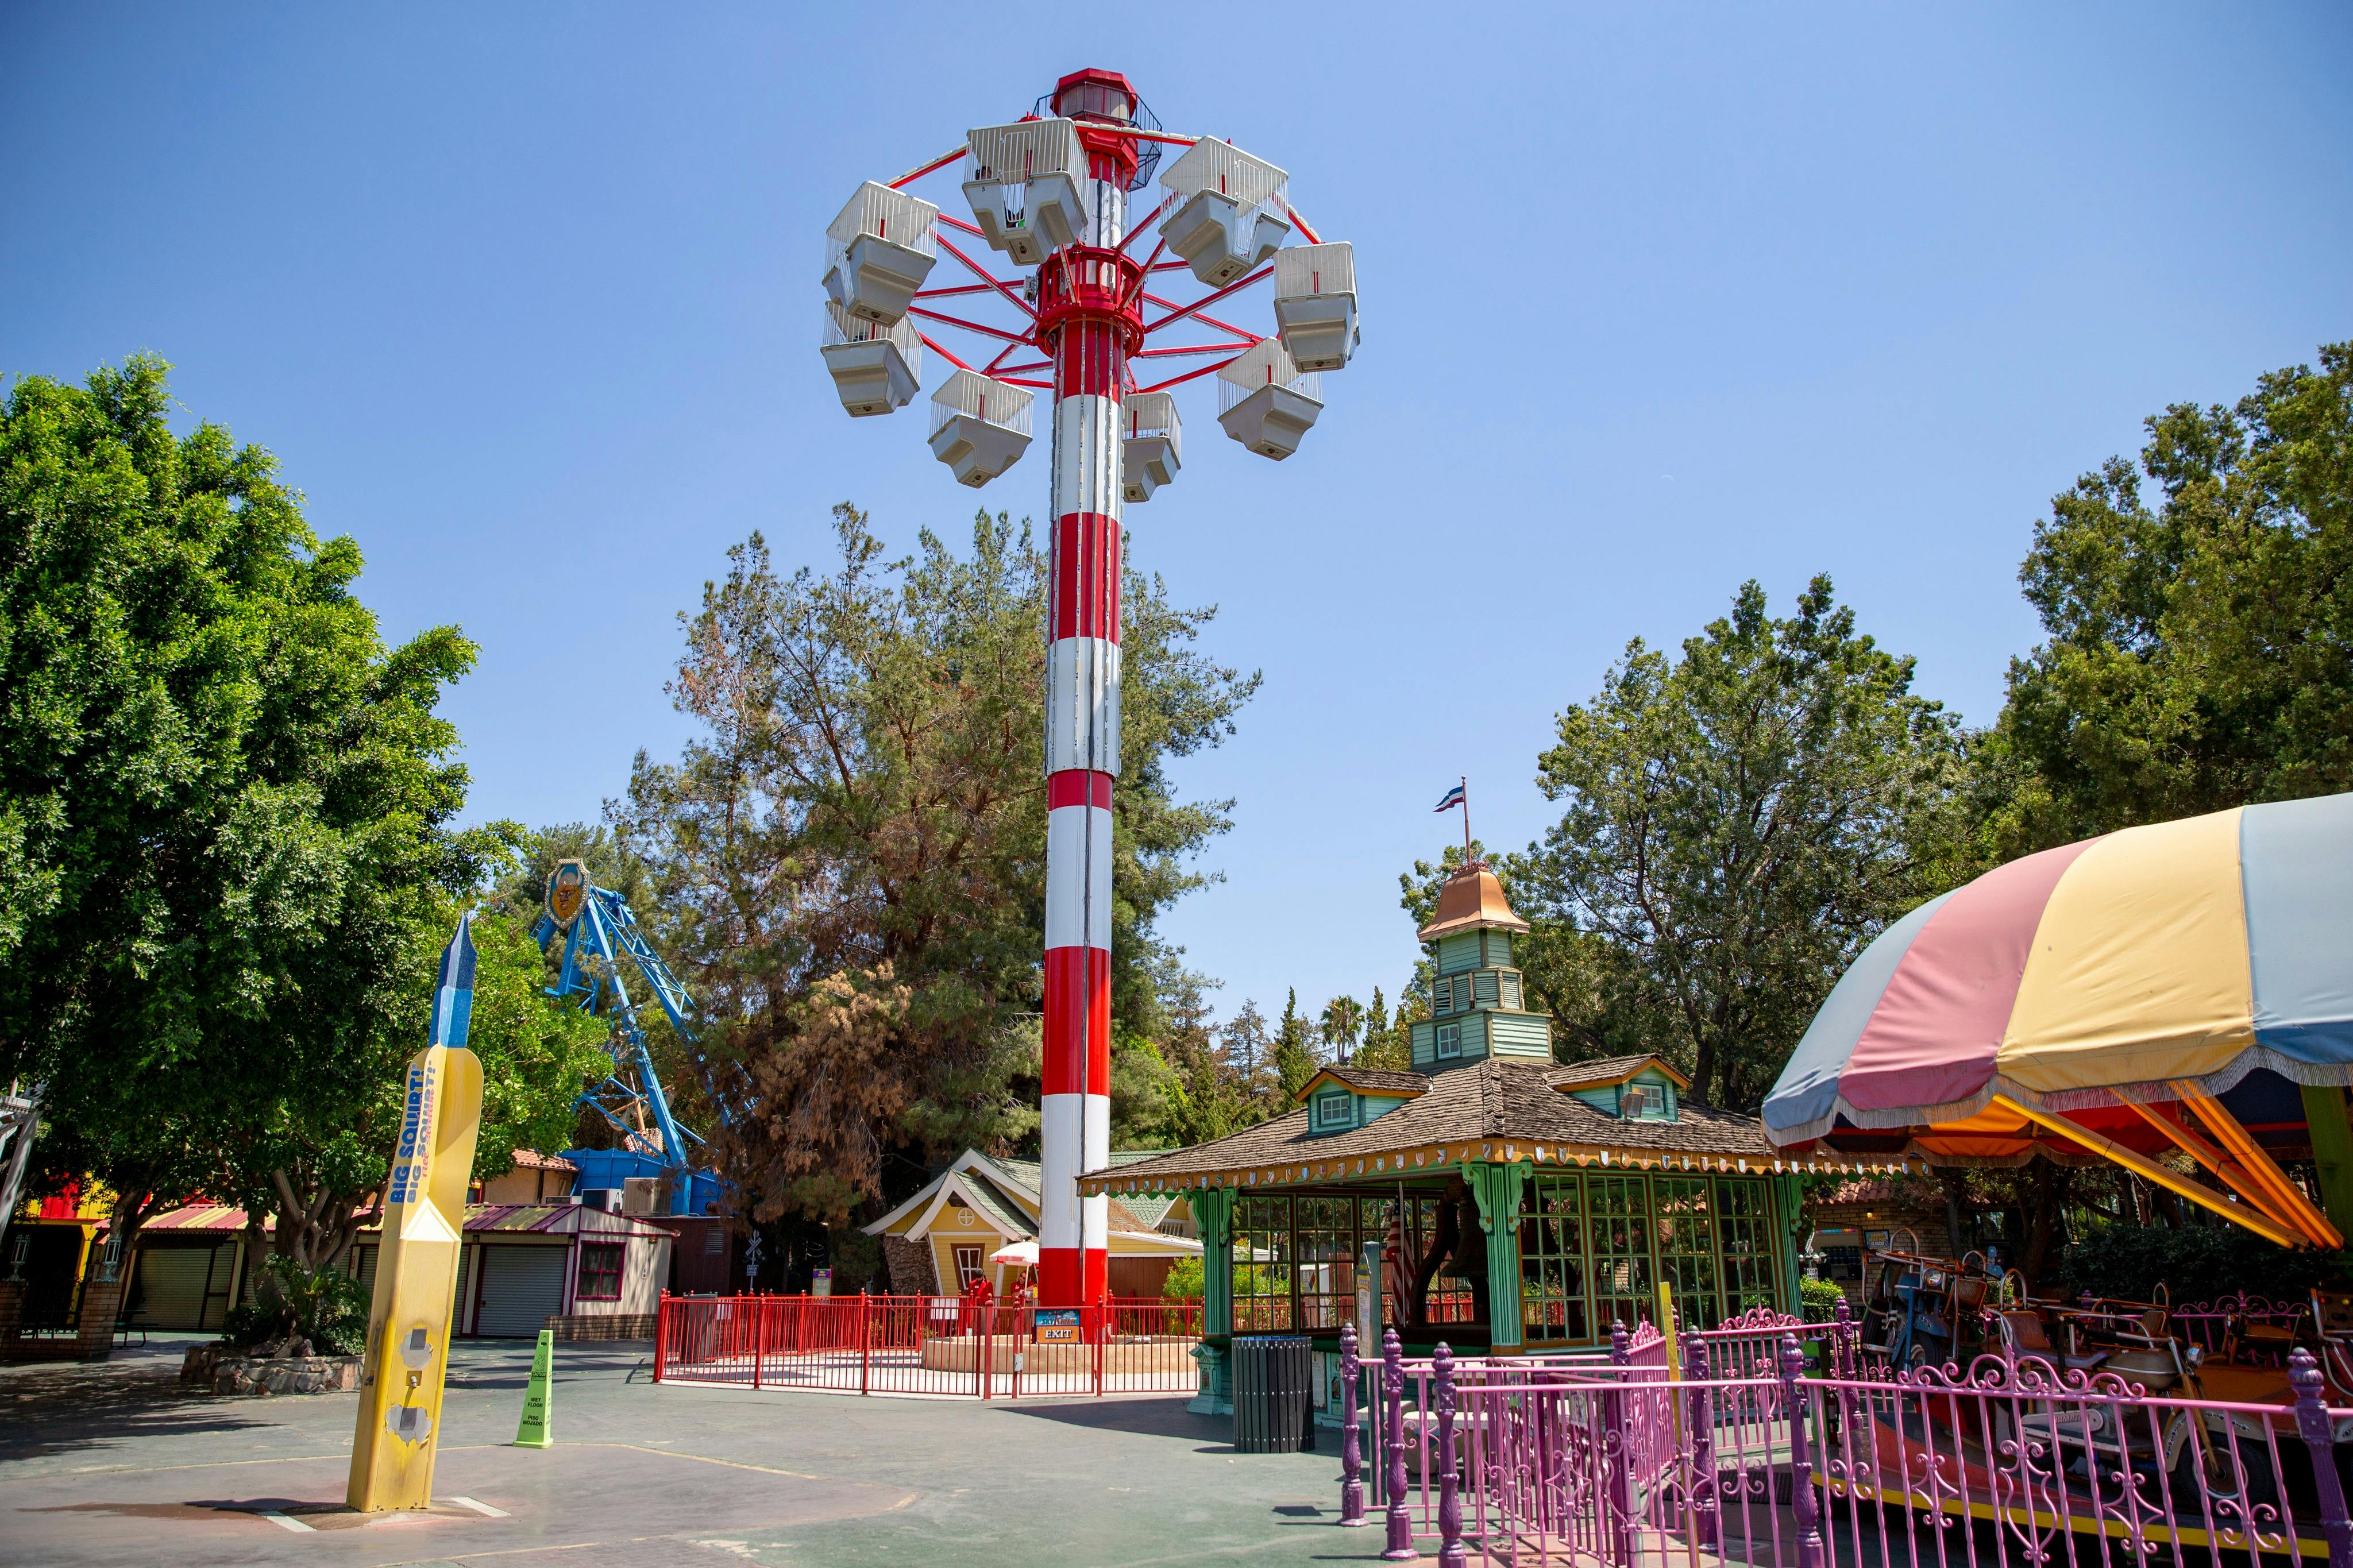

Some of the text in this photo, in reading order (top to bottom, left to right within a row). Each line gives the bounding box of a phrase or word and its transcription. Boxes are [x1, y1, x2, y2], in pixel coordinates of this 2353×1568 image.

[389, 1166, 411, 1203] BIG
[407, 1165, 422, 1203] BIG
[1045, 1330, 1072, 1339] EXIT
